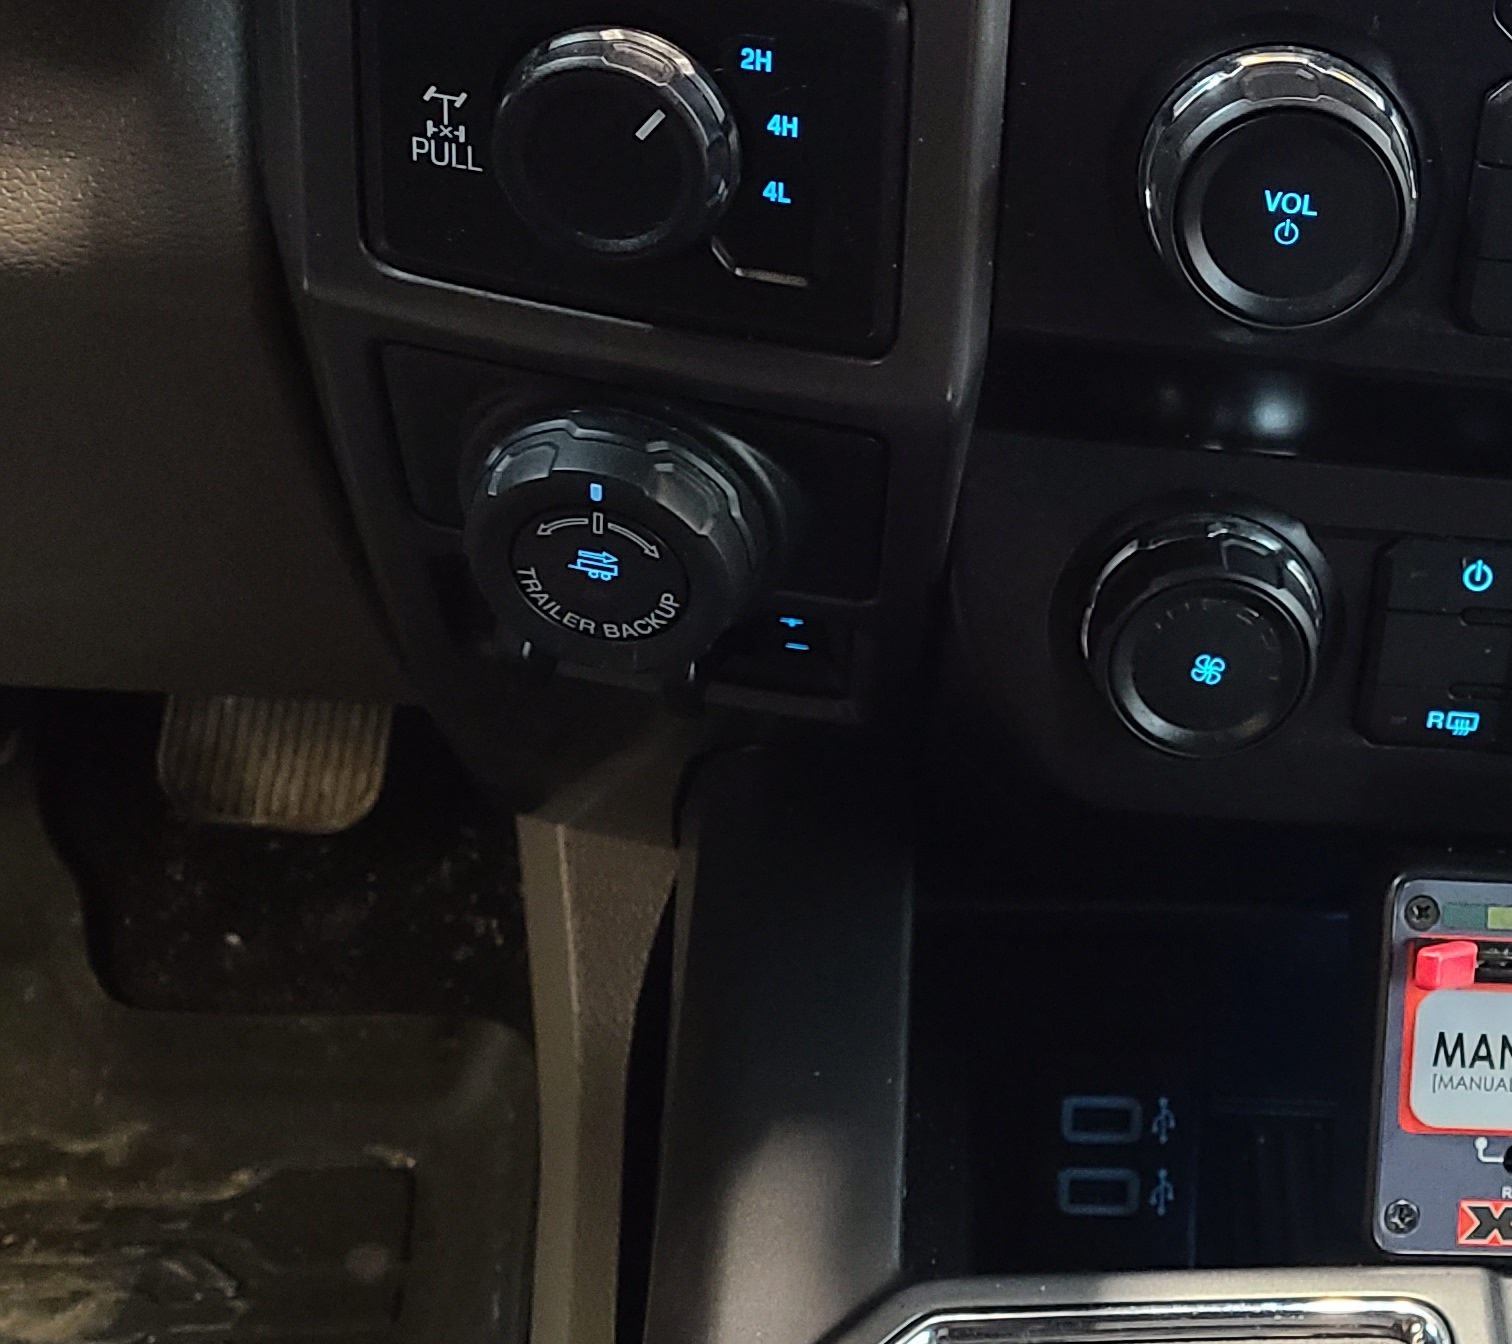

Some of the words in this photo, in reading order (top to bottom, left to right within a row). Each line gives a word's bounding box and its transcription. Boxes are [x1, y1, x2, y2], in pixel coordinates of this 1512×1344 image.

[740, 46, 774, 74] 2H
[766, 114, 800, 138] 4H
[411, 135, 484, 173] PULL
[762, 181, 792, 205] 4L
[1264, 189, 1318, 217] VOL
[517, 565, 597, 636] TRAILER
[602, 591, 681, 640] BACKUP
[1426, 711, 1443, 730] R
